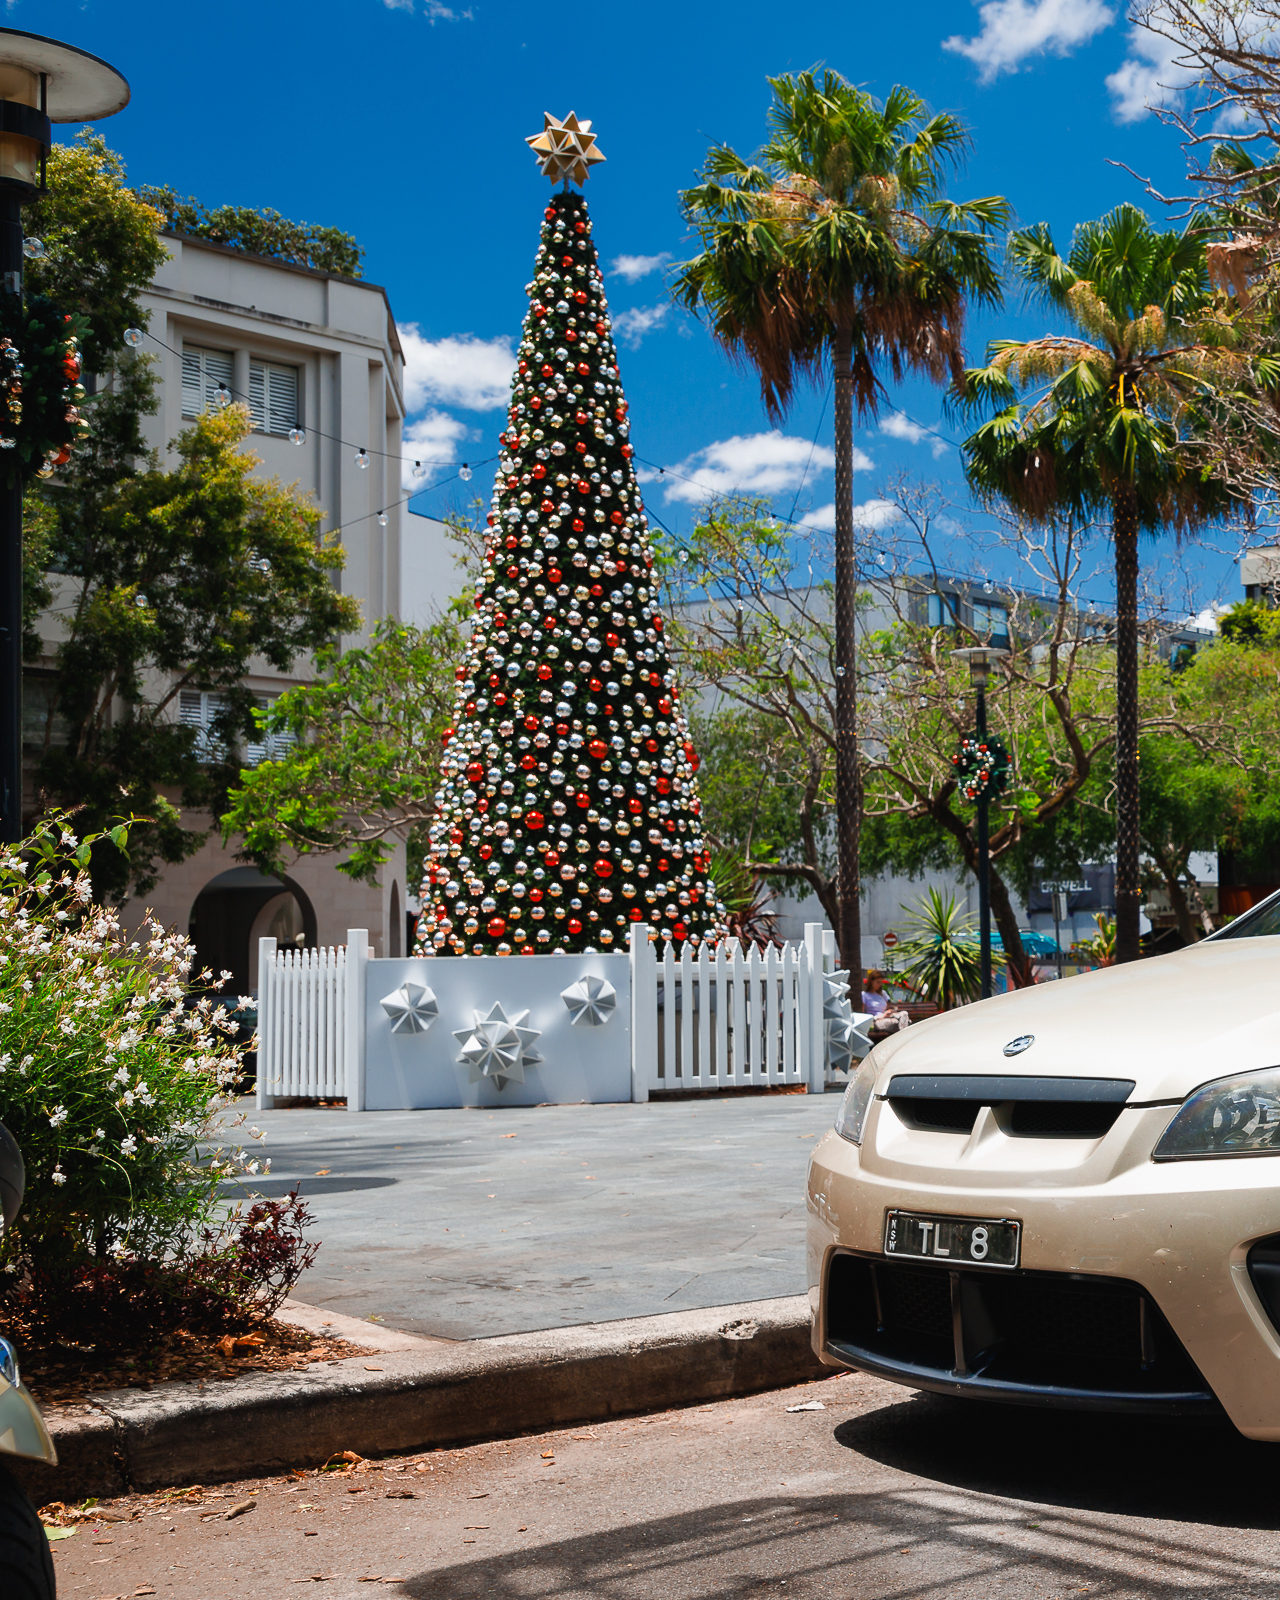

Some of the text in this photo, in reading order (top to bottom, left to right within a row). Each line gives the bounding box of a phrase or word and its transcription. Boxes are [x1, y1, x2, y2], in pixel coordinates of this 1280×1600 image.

[889, 1219, 898, 1251] NSW
[918, 1222, 989, 1260] TL 8
